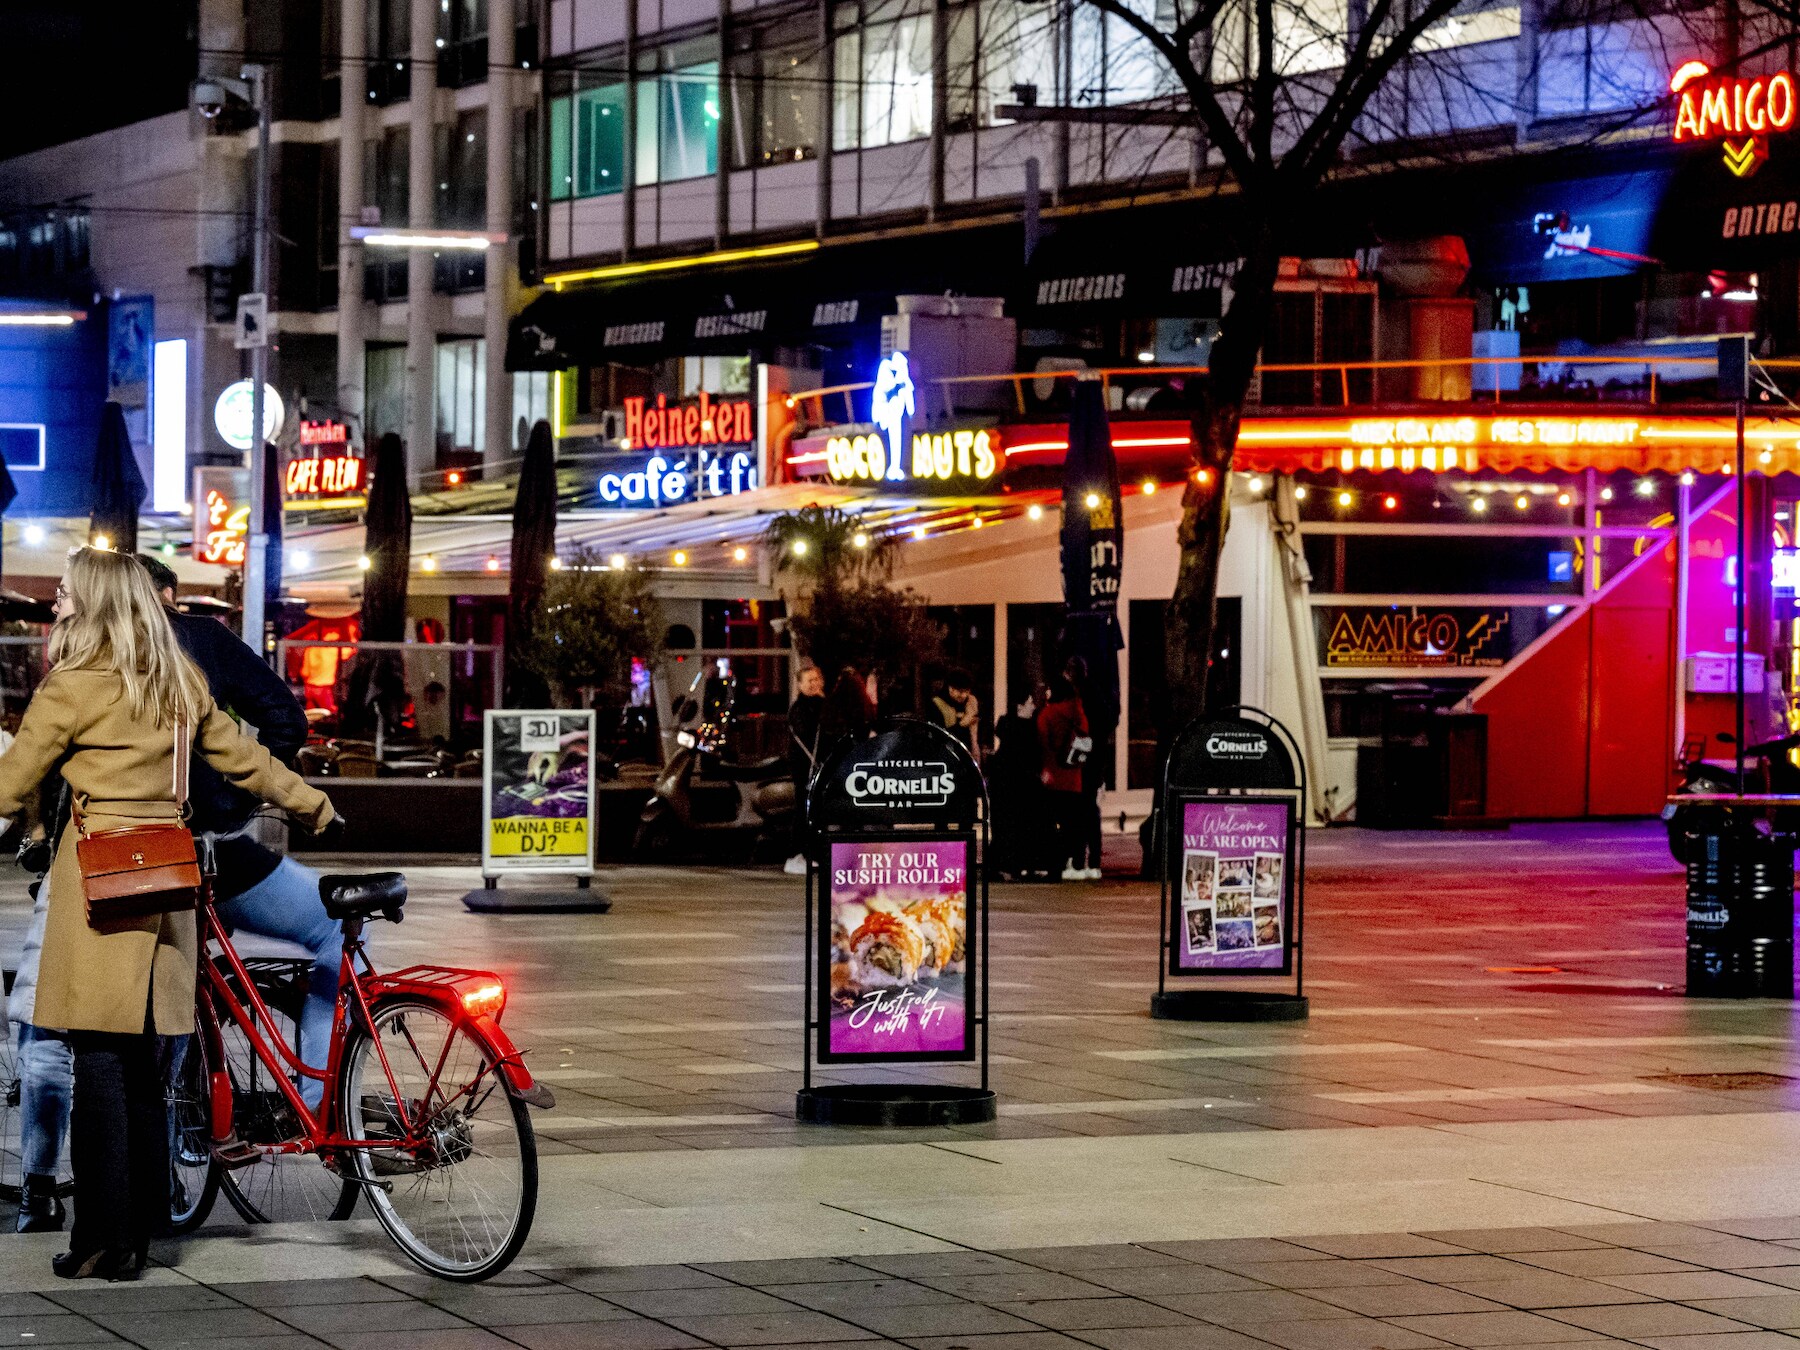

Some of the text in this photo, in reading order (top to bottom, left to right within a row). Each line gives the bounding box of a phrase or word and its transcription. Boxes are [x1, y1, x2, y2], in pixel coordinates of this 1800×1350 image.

[1673, 75, 1793, 140] AMIGO
[624, 392, 753, 449] Heineken
[1350, 419, 1638, 443] MEXICAANS RESTAURANT
[827, 429, 996, 481] COCO NUTS
[599, 456, 687, 501] café
[1327, 612, 1460, 655] AMIGO
[1206, 737, 1268, 753] CORNELIS
[877, 760, 924, 768] KITCHEN
[845, 770, 956, 798] CORNELIS
[493, 820, 584, 834] WANNA BE A
[1203, 814, 1268, 834] Welcome
[521, 835, 558, 852] DJ?
[1184, 834, 1209, 848] WE
[1211, 834, 1239, 848] ARE
[857, 852, 939, 869] TRY OUR
[834, 867, 962, 885] SUSHI ROLLS!
[848, 986, 939, 1029] Just roll
[873, 1001, 946, 1036] with it!
